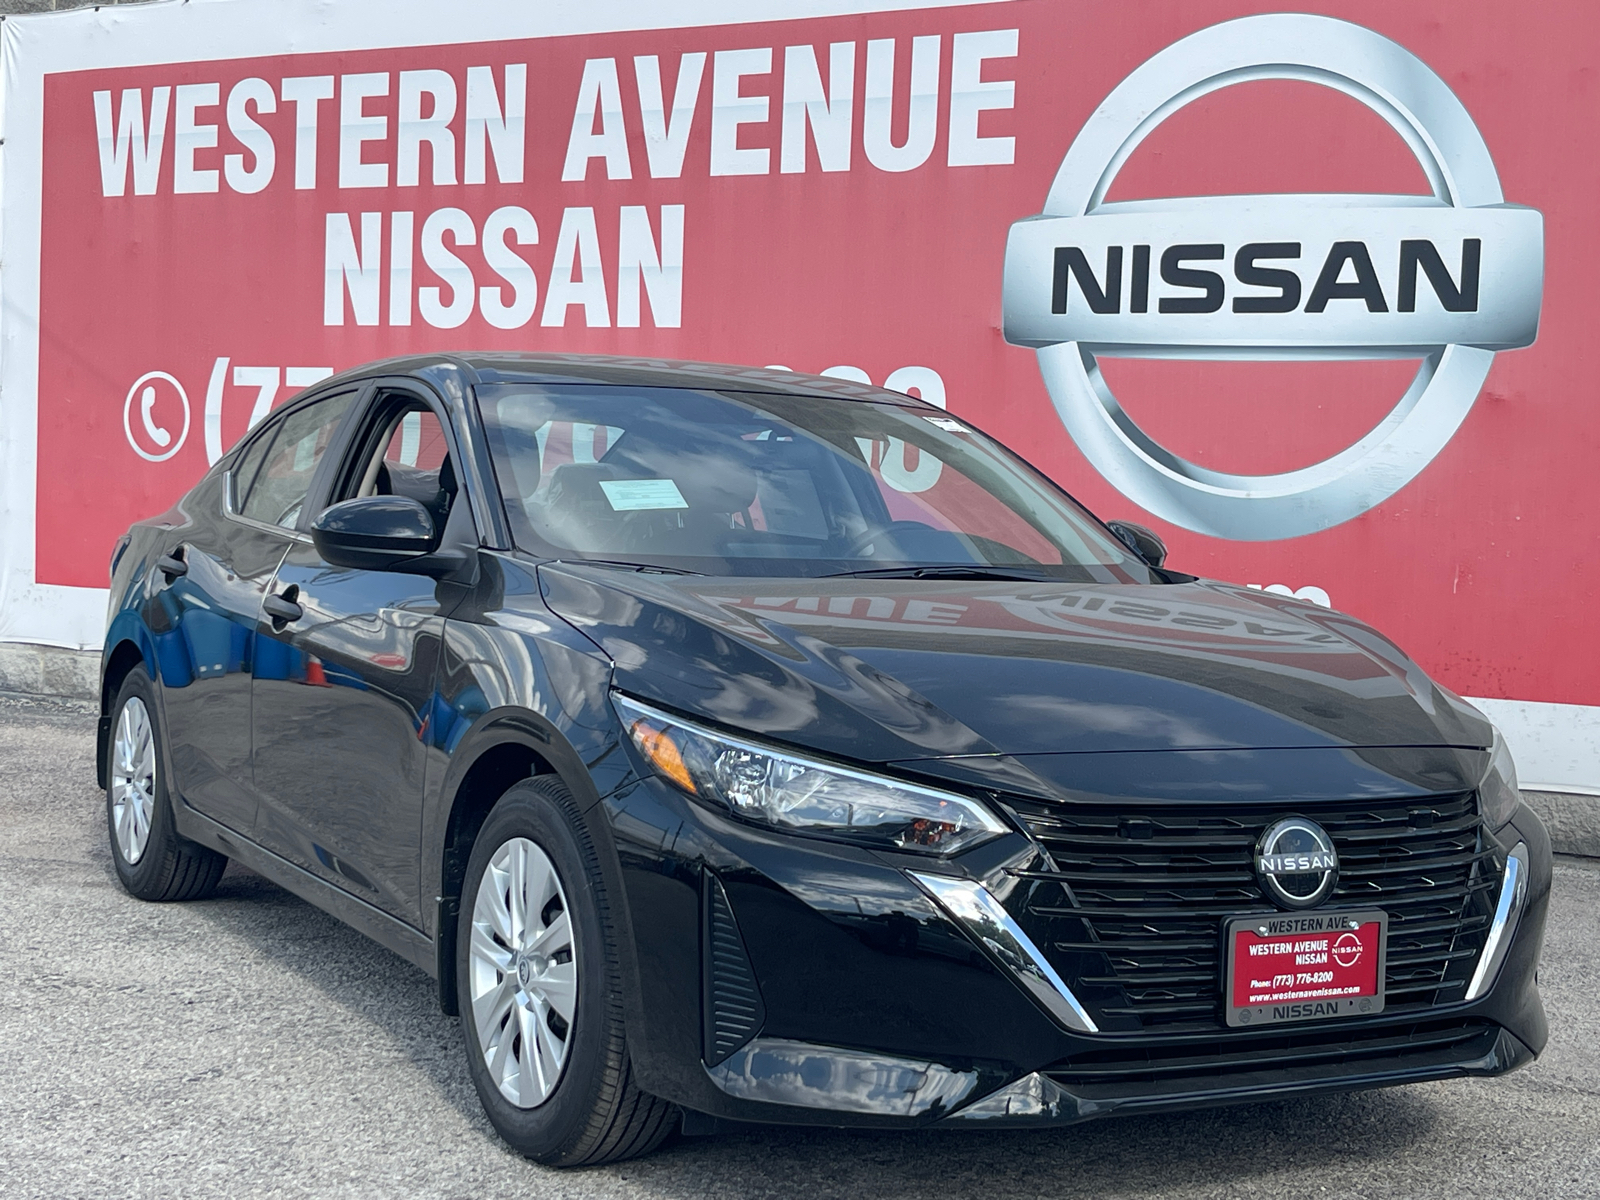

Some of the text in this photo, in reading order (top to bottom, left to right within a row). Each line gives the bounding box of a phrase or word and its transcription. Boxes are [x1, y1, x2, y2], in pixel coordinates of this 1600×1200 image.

[92, 28, 1020, 197] WESTERN AVENUE
[323, 203, 686, 329] NISSAN
[1051, 238, 1481, 315] NISSAN
[1261, 855, 1334, 871] NISSAN
[1268, 919, 1322, 934] WESTERN
[1249, 939, 1328, 957] WESTERN AVENUE
[1332, 945, 1363, 954] NISSAN
[1295, 952, 1328, 966] NISSAN
[1250, 970, 1333, 989] Phone: (773) 776-8200
[1249, 985, 1361, 1003] www.westernavenissan.com
[1272, 1001, 1338, 1019] NISSAN
